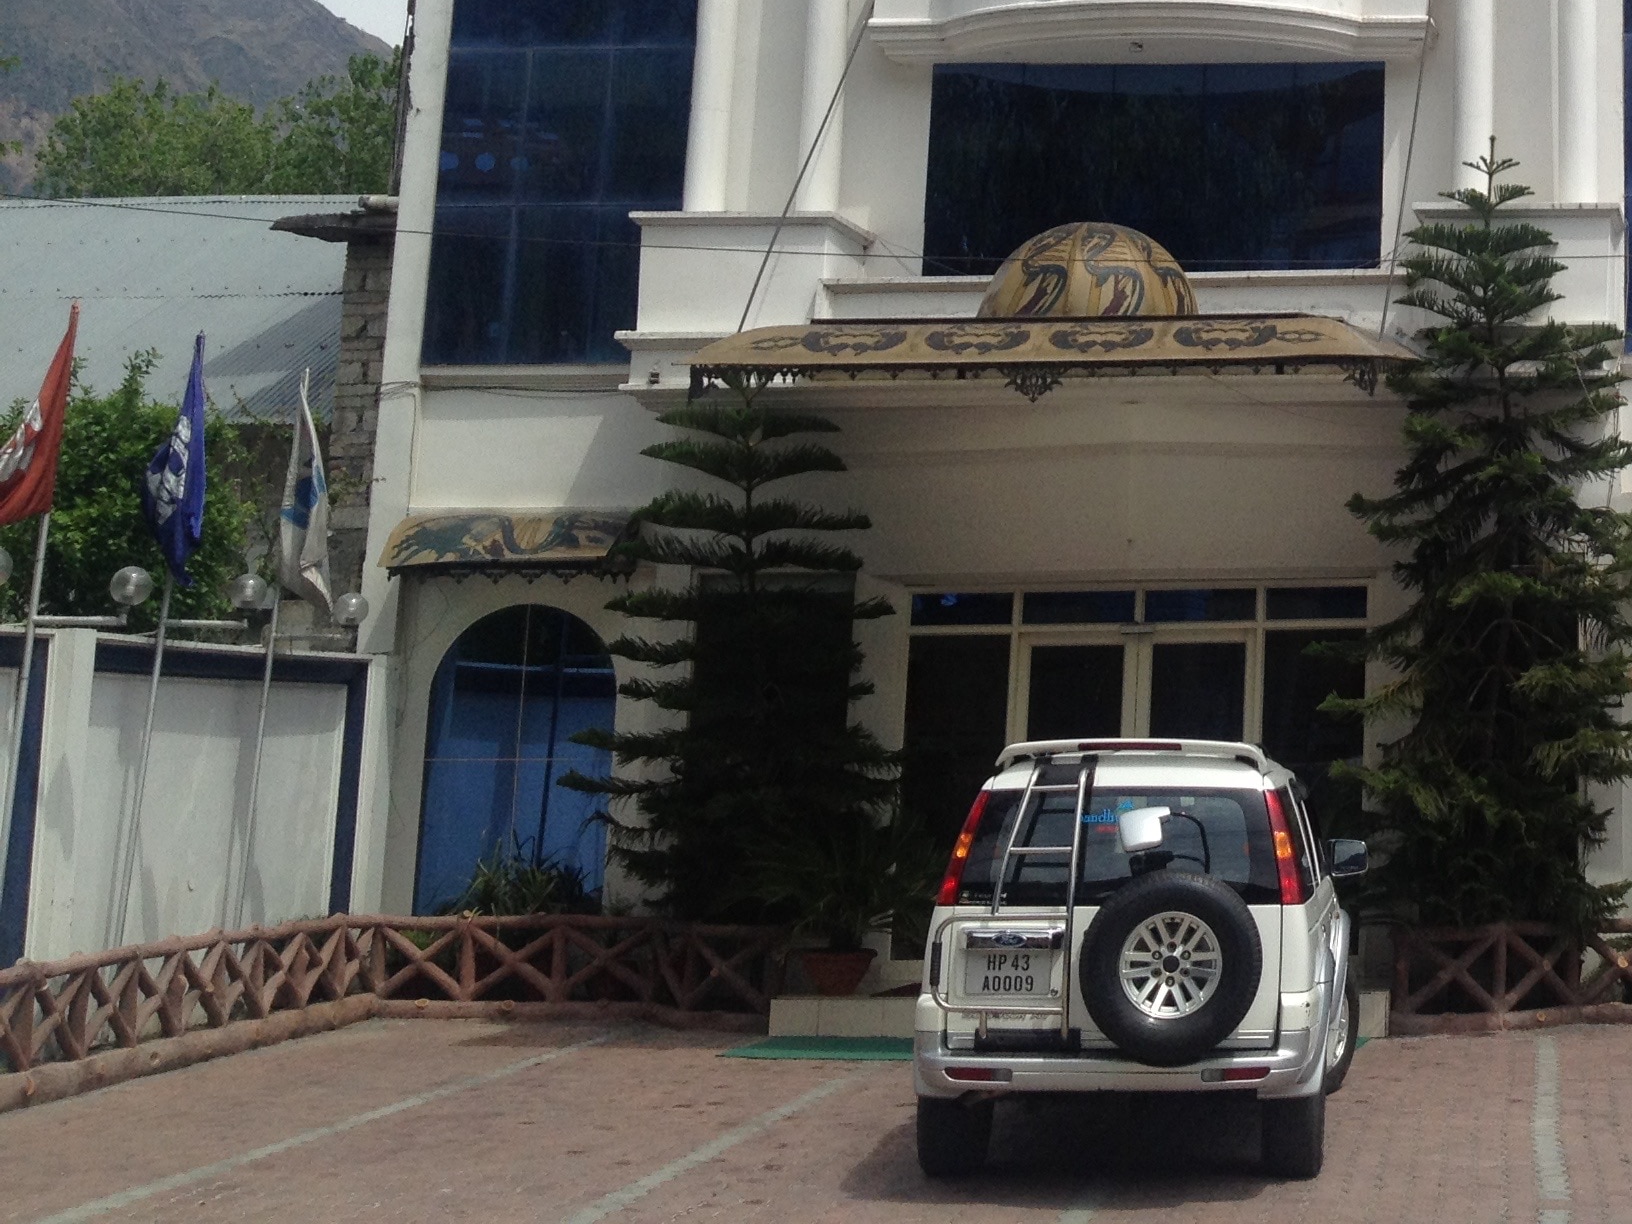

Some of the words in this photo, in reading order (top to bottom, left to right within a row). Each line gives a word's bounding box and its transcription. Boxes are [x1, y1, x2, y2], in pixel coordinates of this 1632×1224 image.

[987, 954, 1007, 971] HP
[1011, 954, 1030, 971] 43
[982, 975, 1034, 992] A0009
